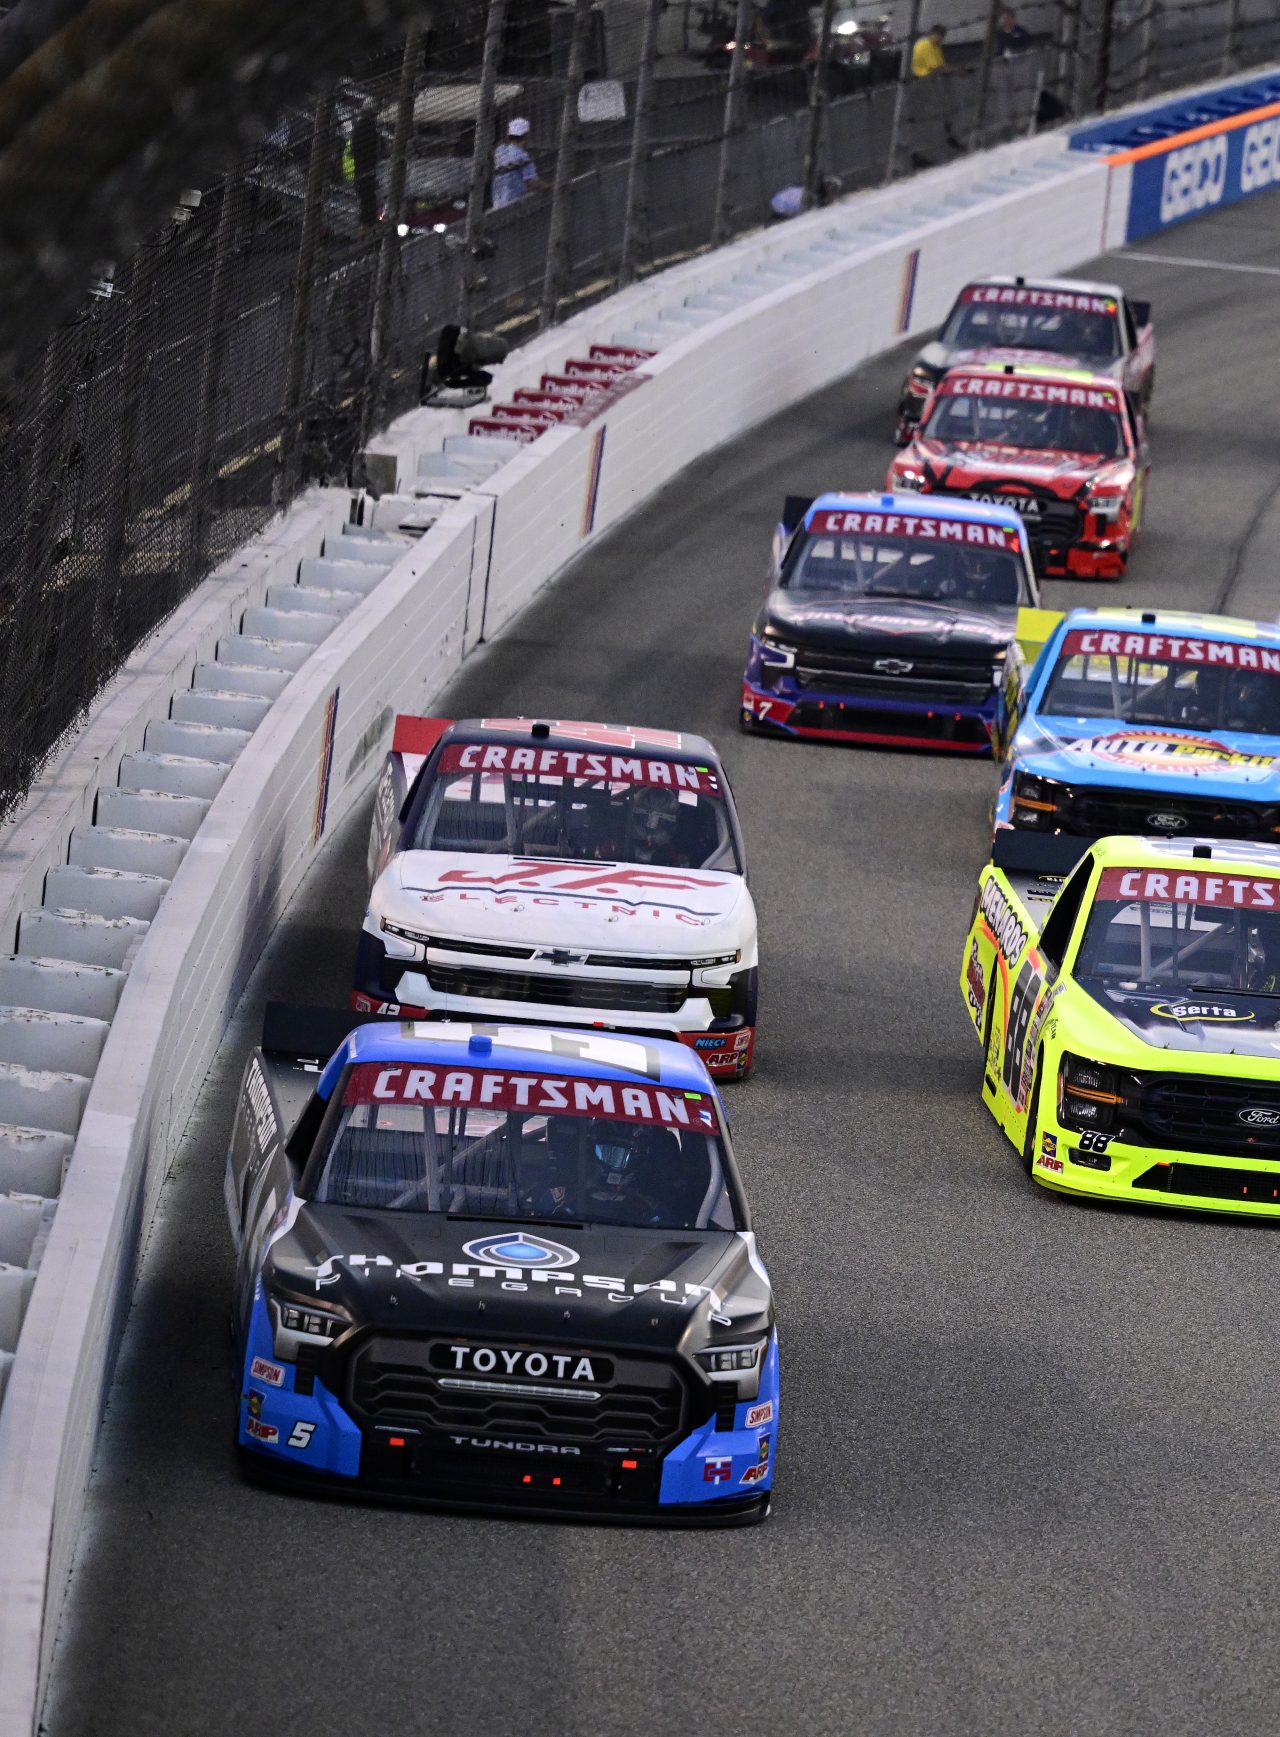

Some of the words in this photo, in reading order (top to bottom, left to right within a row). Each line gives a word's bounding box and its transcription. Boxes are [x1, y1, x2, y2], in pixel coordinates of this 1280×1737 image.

[1160, 134, 1229, 223] GEICO
[972, 288, 1106, 313] CRAFTSMAN
[952, 378, 1104, 408] CRAFTSMAN
[825, 514, 1006, 547] CRAFTSMAN
[758, 701, 773, 720] 7
[1064, 739, 1168, 754] AUTO
[459, 746, 700, 787] CRAFTSMAN
[420, 893, 702, 926] ELECTRIC
[707, 1053, 739, 1064] ARP
[372, 1069, 691, 1125] CRAFTSMAN
[1247, 1110, 1280, 1124] Ford
[1079, 1130, 1116, 1155] 88
[1036, 1155, 1064, 1172] ARP
[304, 1254, 722, 1311] THOMPSON
[451, 1346, 595, 1381] TOYOTA
[287, 1421, 316, 1449] 5
[450, 1436, 581, 1456] TUNDRA
